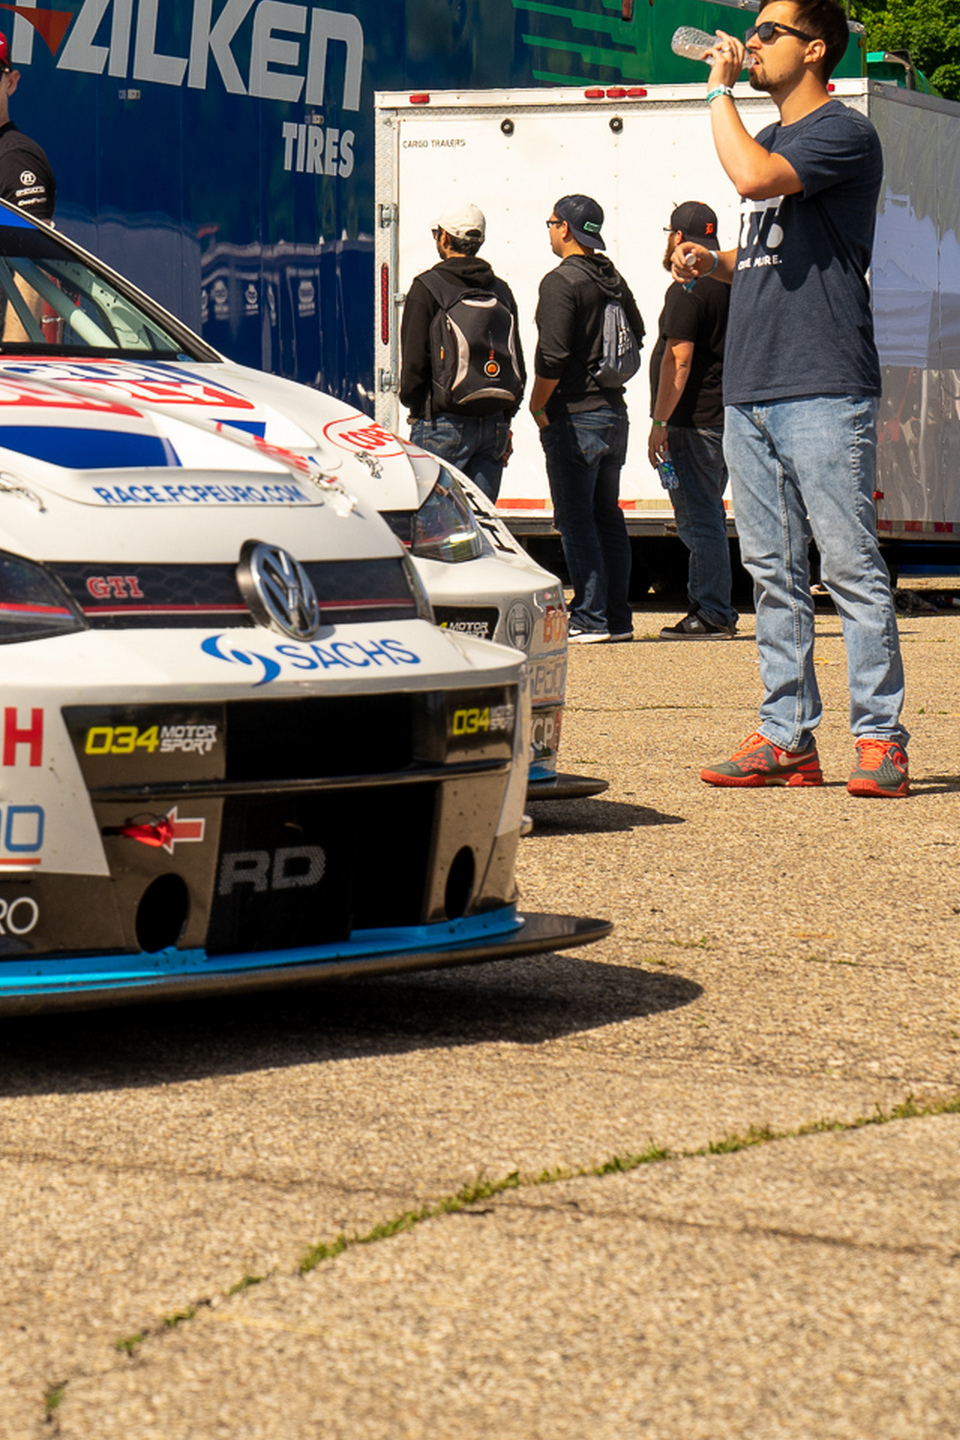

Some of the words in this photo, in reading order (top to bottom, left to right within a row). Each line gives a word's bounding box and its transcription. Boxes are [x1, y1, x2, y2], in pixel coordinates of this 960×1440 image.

[281, 121, 355, 179] TIRES
[402, 140, 429, 149] CARGO
[431, 139, 466, 148] TRAILERS
[93, 484, 312, 505] RACE.FCPEURO.COM
[86, 576, 144, 599] GTI
[275, 639, 421, 670] SACHS
[452, 707, 489, 736] 034
[85, 726, 159, 754] 034
[160, 725, 217, 740] MOTOR
[160, 738, 215, 755] SPORT
